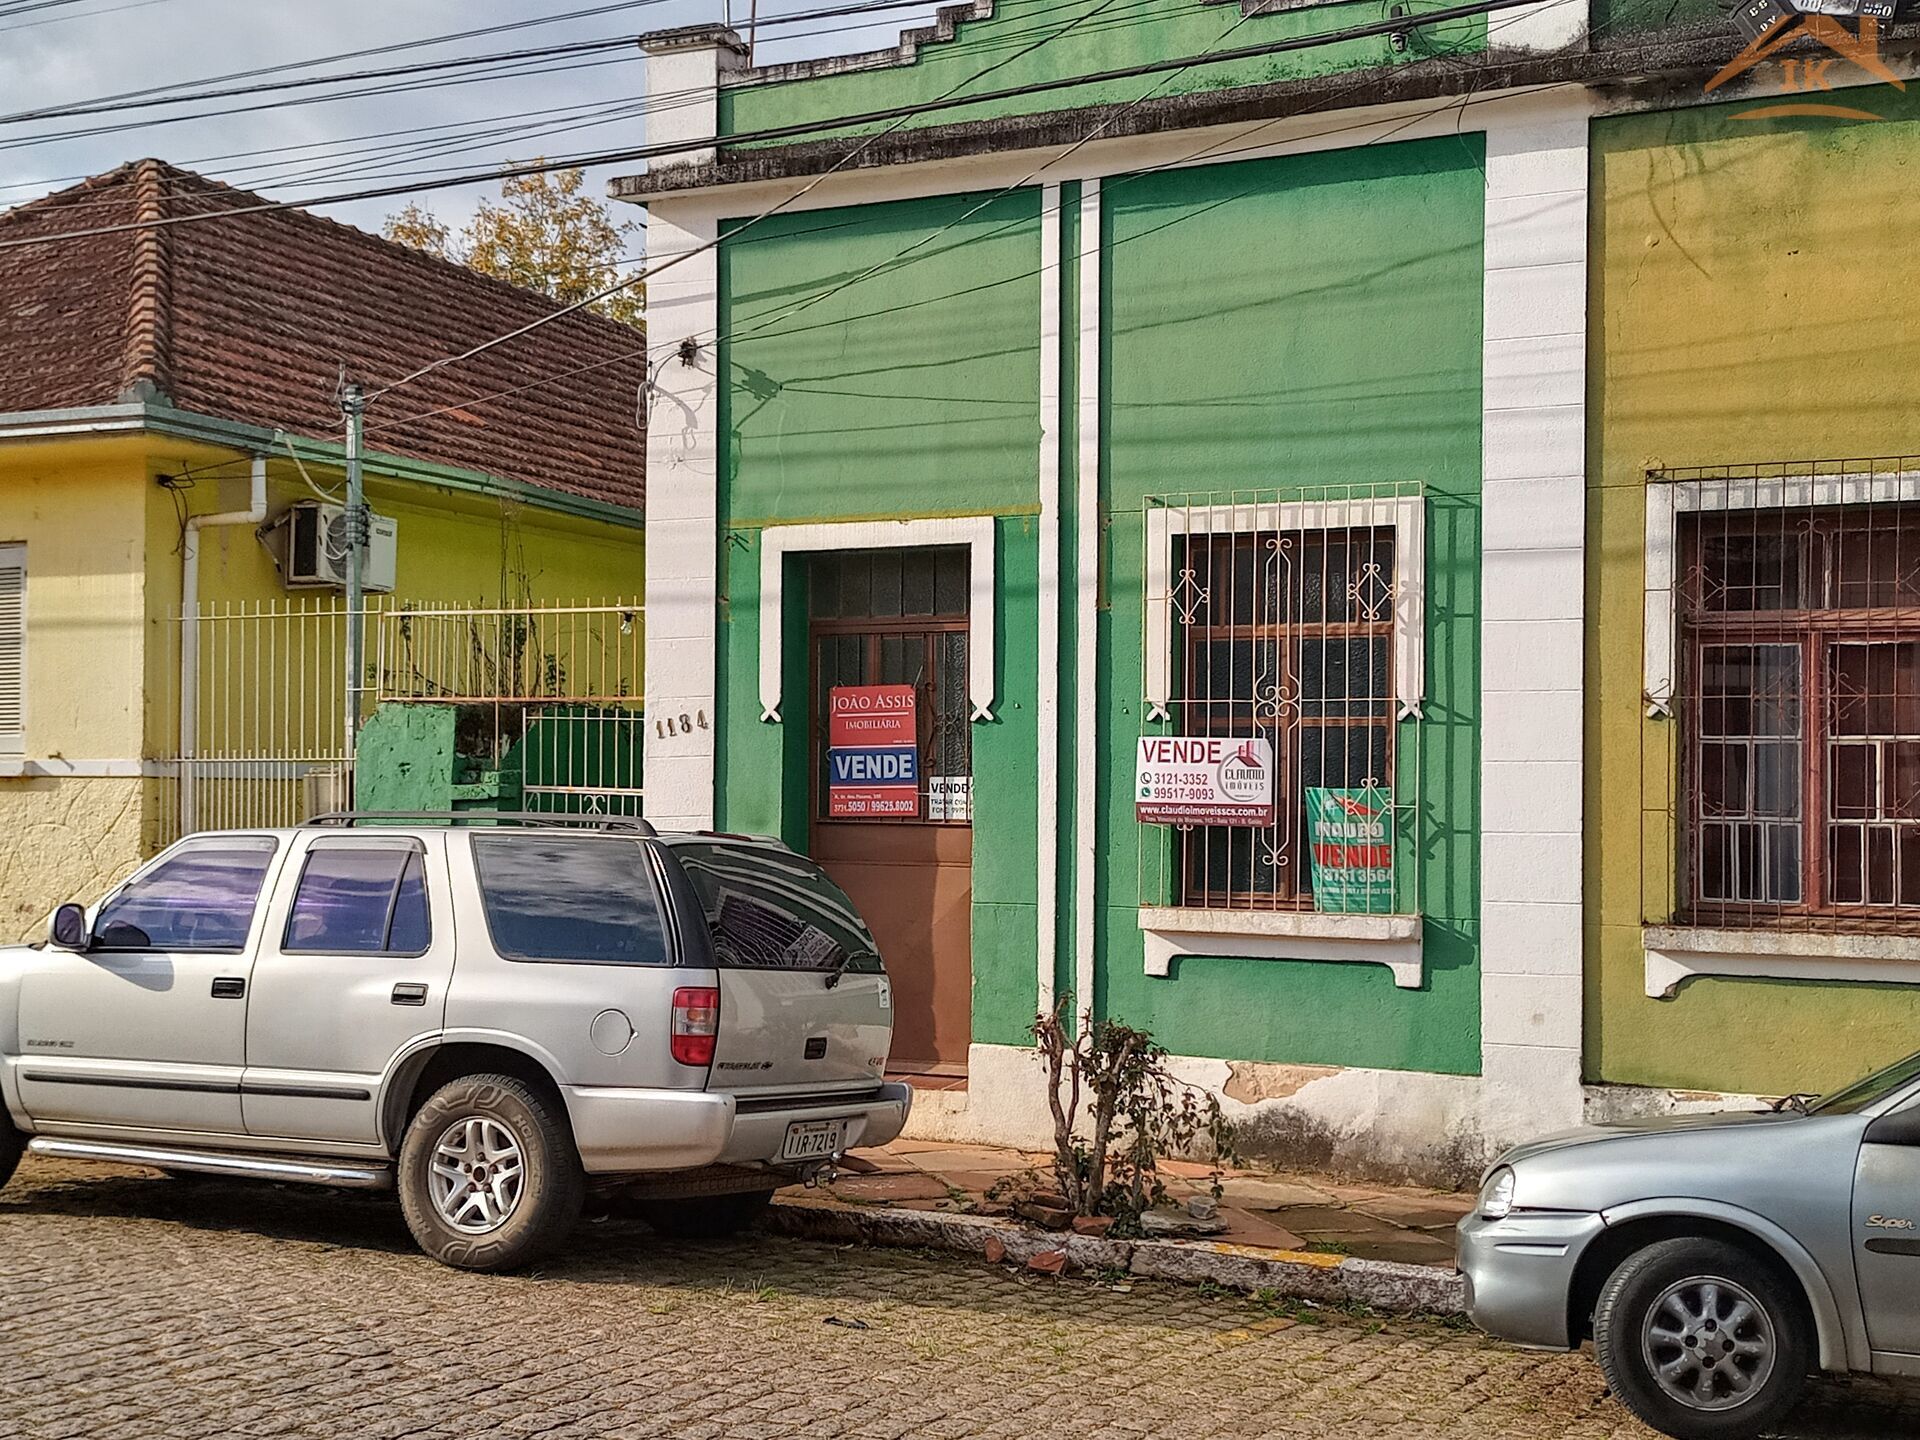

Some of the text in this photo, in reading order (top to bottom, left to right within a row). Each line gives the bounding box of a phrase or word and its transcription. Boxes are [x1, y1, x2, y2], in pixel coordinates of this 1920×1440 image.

[832, 694, 914, 713] JOÃO ASSIS
[656, 709, 709, 739] 1184
[845, 718, 901, 729] IMOBILIÁRIA
[1142, 739, 1222, 764] VENDE
[835, 754, 913, 780] VENDE
[1225, 768, 1265, 780] CLAUDIO
[1154, 772, 1208, 785] 3121-3352
[1154, 787, 1215, 800] 99517-9093
[1313, 843, 1392, 868] VENDE
[1864, 1214, 1916, 1230] Super
